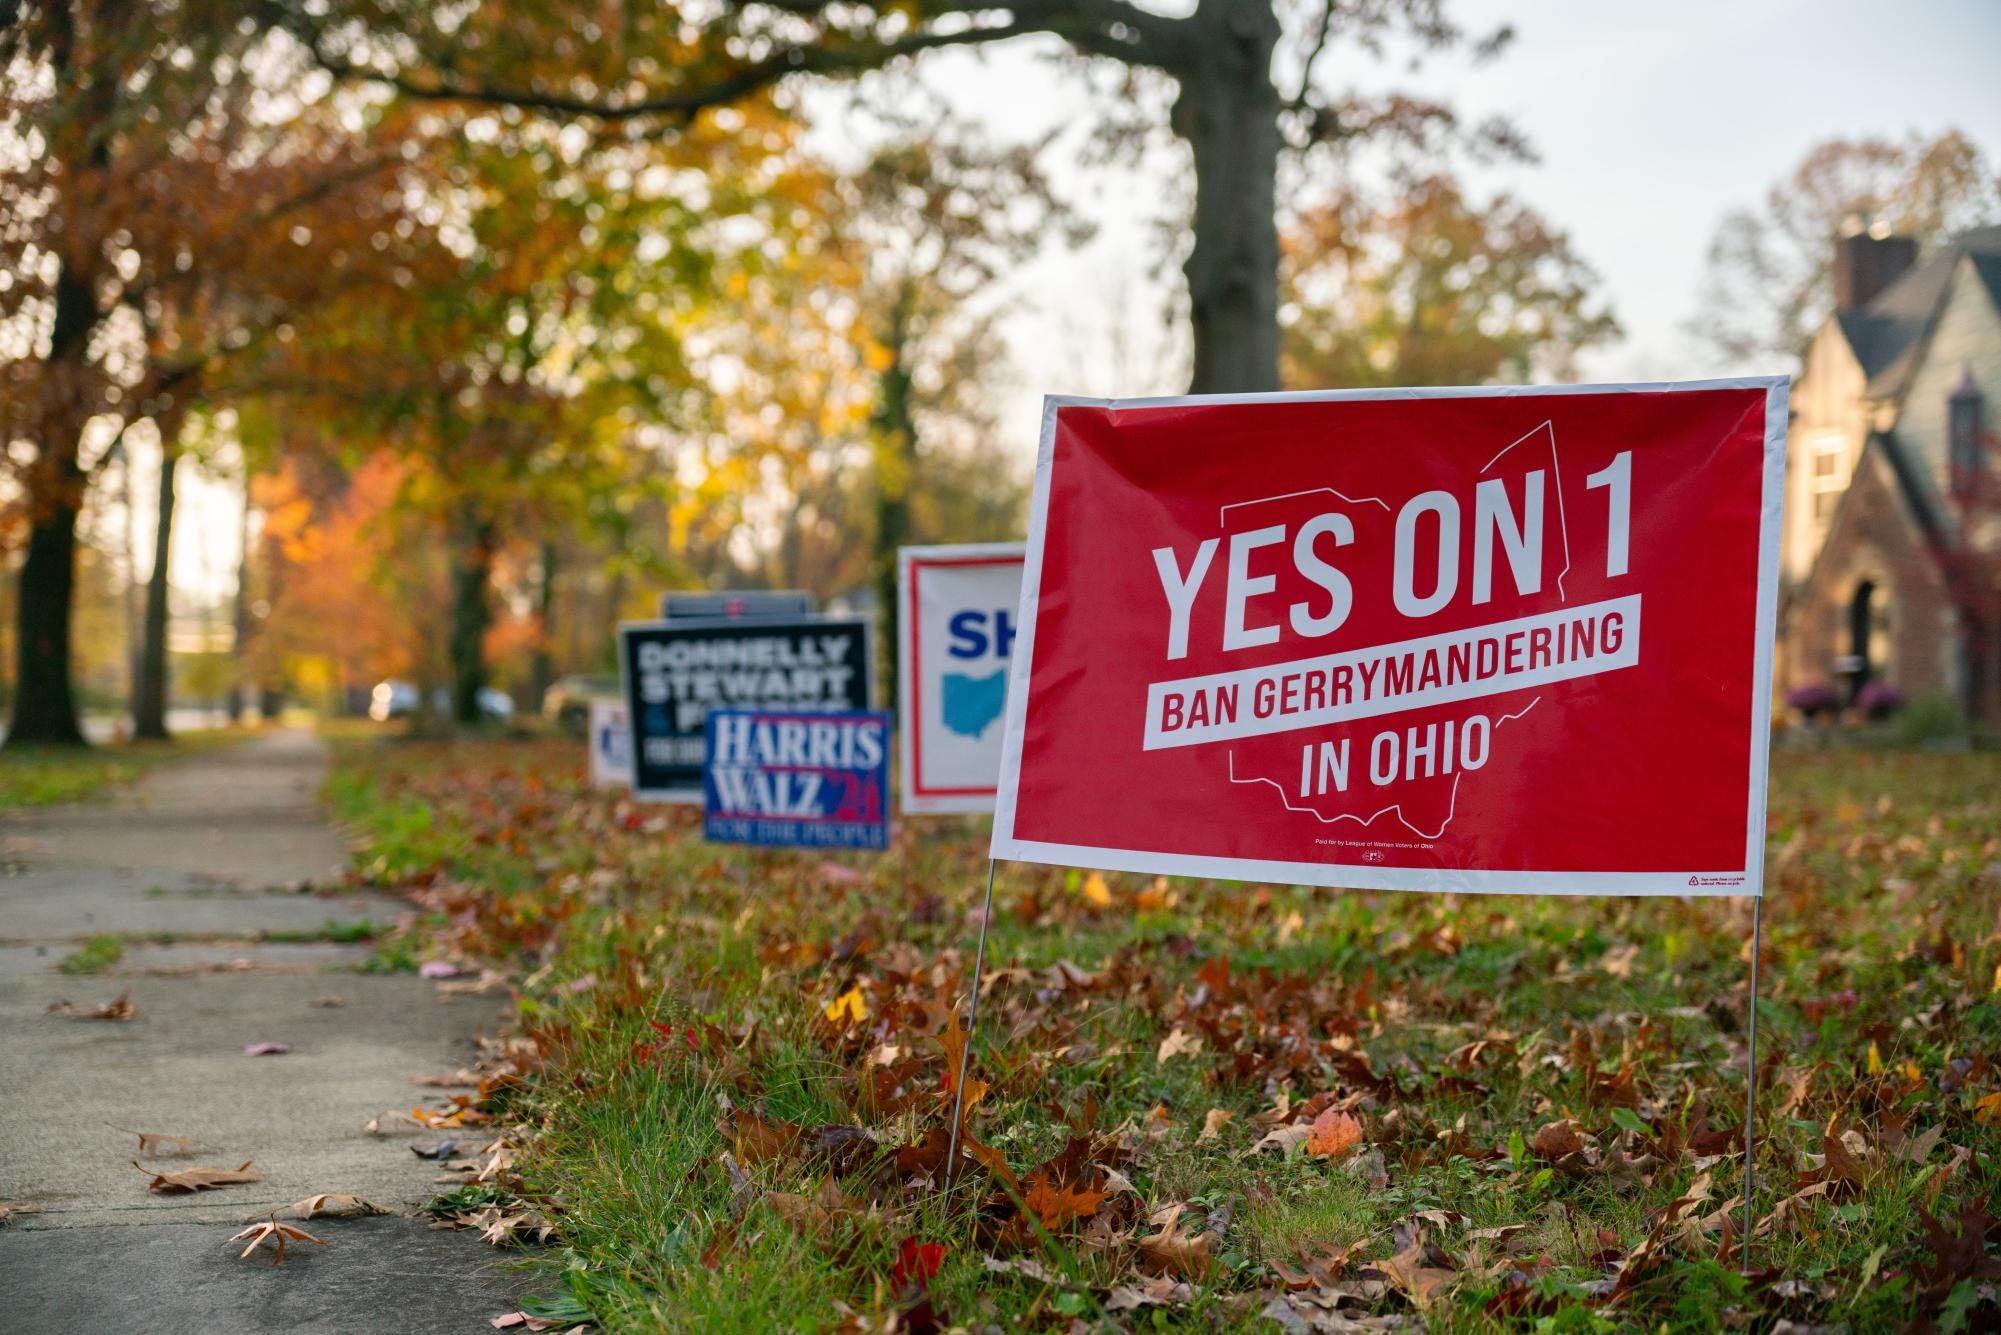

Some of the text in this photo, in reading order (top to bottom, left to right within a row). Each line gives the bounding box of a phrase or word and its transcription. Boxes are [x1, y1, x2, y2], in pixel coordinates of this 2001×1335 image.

[1152, 450, 1632, 661] YES ON 1
[638, 634, 852, 669] DONNELLY
[1160, 611, 1625, 732] BAN GERRYMANDERING
[640, 666, 853, 703] STEWART
[714, 714, 883, 770] HARRIS
[1300, 714, 1491, 798] IN OHIO
[711, 765, 824, 817] WALZ
[1345, 840, 1366, 848] League
